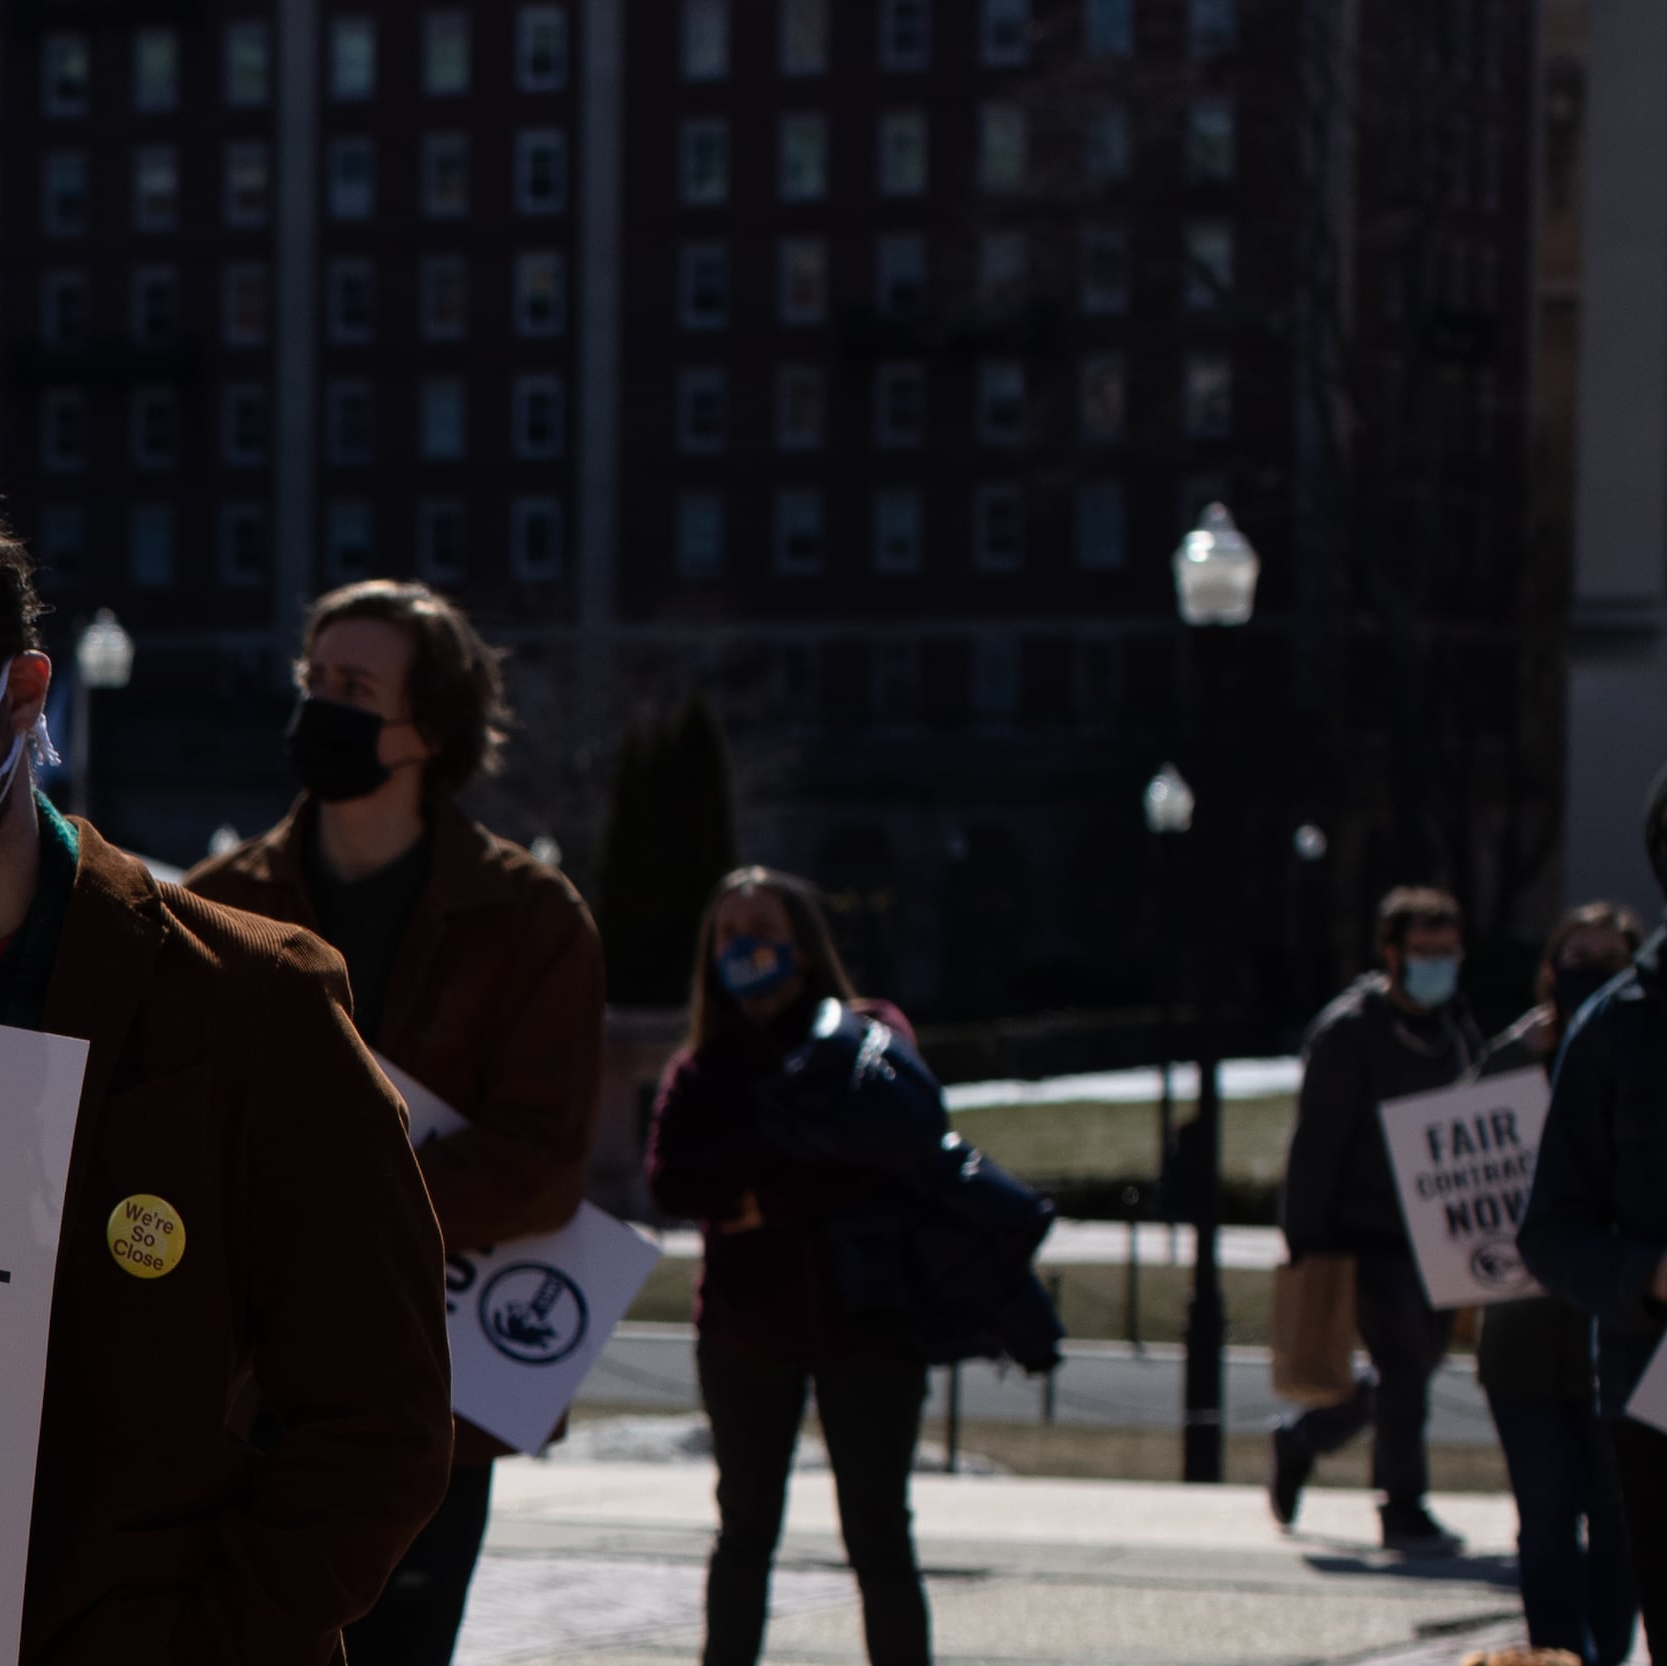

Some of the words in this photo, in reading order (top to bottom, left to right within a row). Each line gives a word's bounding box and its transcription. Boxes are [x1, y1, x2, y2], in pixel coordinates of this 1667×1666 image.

[1425, 1108, 1521, 1165] FAIR
[1417, 1152, 1534, 1200] CONTRAC
[126, 1202, 173, 1234] We're
[132, 1226, 154, 1246] So
[115, 1240, 163, 1270] Close
